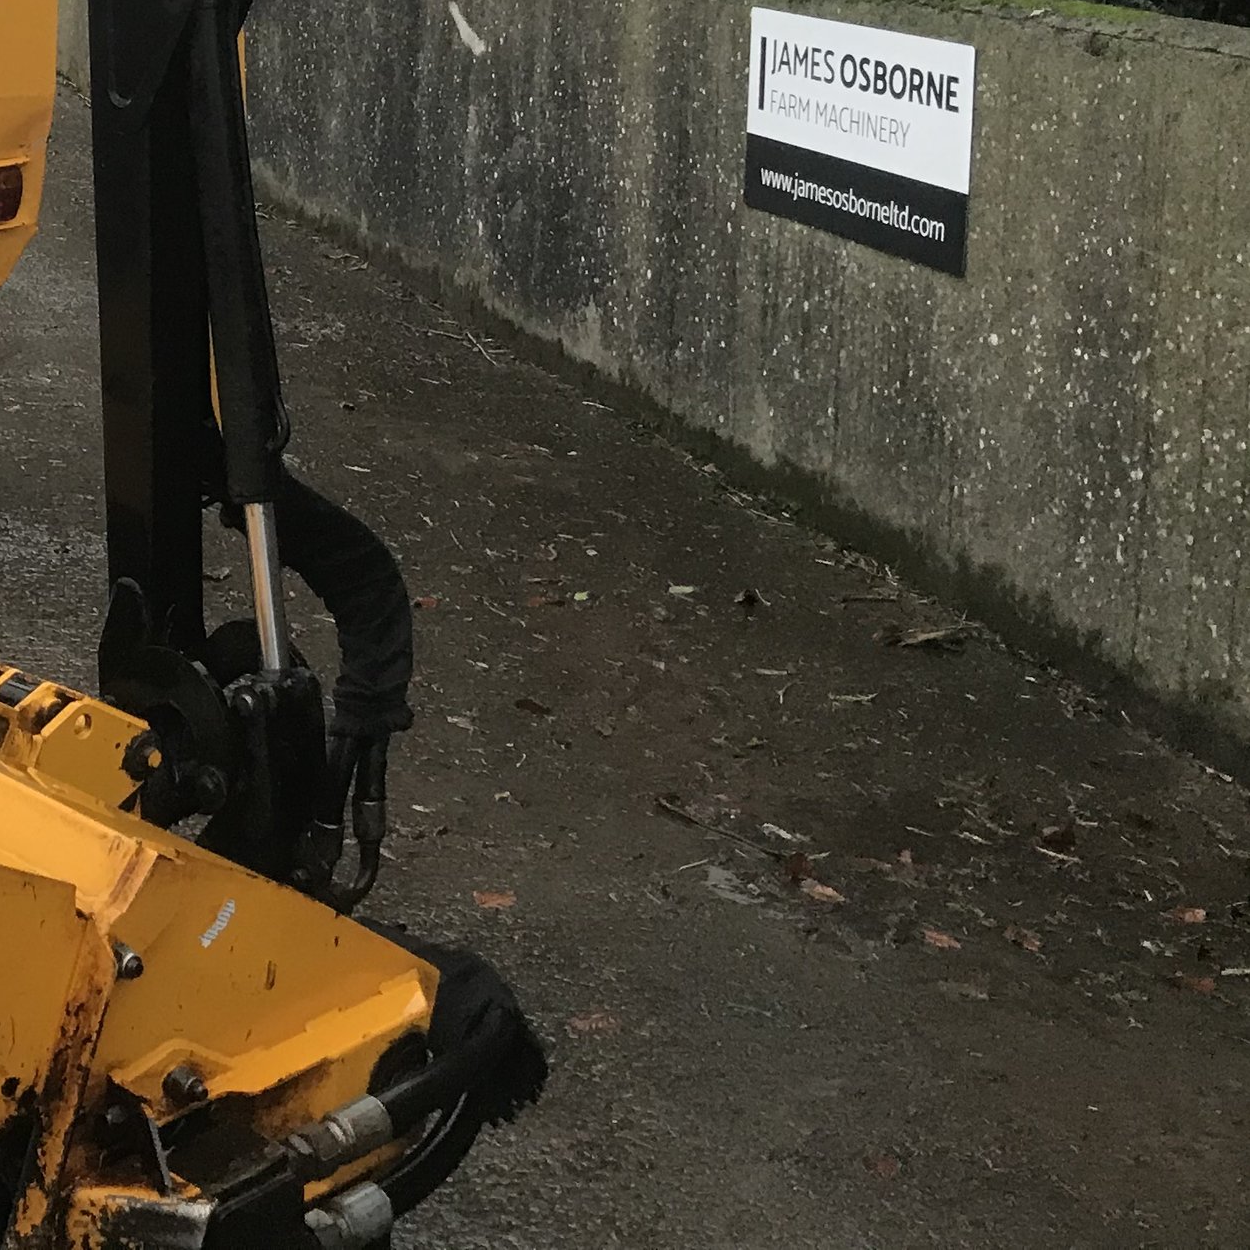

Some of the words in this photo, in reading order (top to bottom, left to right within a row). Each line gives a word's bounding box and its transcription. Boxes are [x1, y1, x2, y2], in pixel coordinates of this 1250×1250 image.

[771, 39, 835, 84] JAMES
[840, 54, 960, 113] OSBORNE
[770, 89, 810, 123] FARM
[815, 101, 911, 148] MACHINERY
[761, 167, 945, 242] www.jamesosborneltd.com
